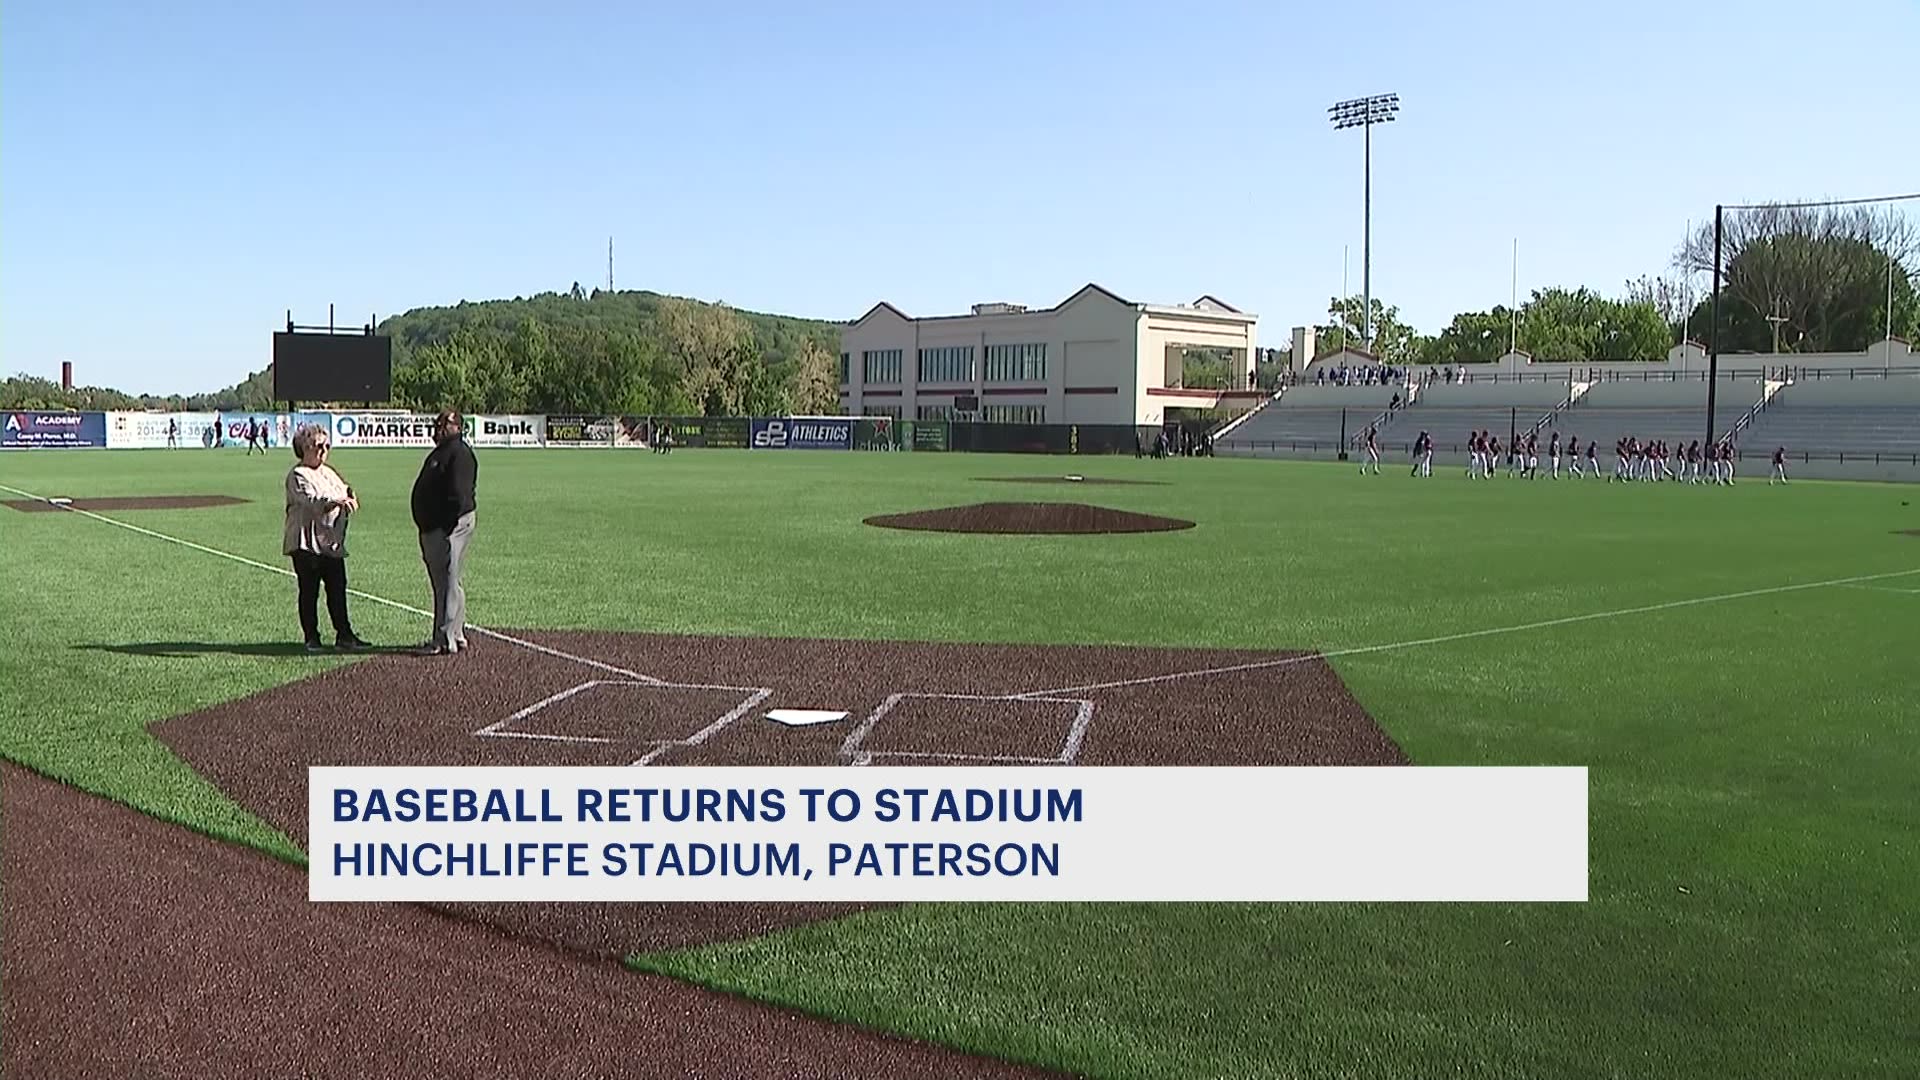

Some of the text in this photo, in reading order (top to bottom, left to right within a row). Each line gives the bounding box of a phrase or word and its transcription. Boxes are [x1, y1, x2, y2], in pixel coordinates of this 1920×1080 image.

[35, 416, 82, 425] ACADEMY
[358, 424, 435, 437] MARKET
[484, 421, 533, 434] Bank
[791, 425, 848, 440] ATHLETICS
